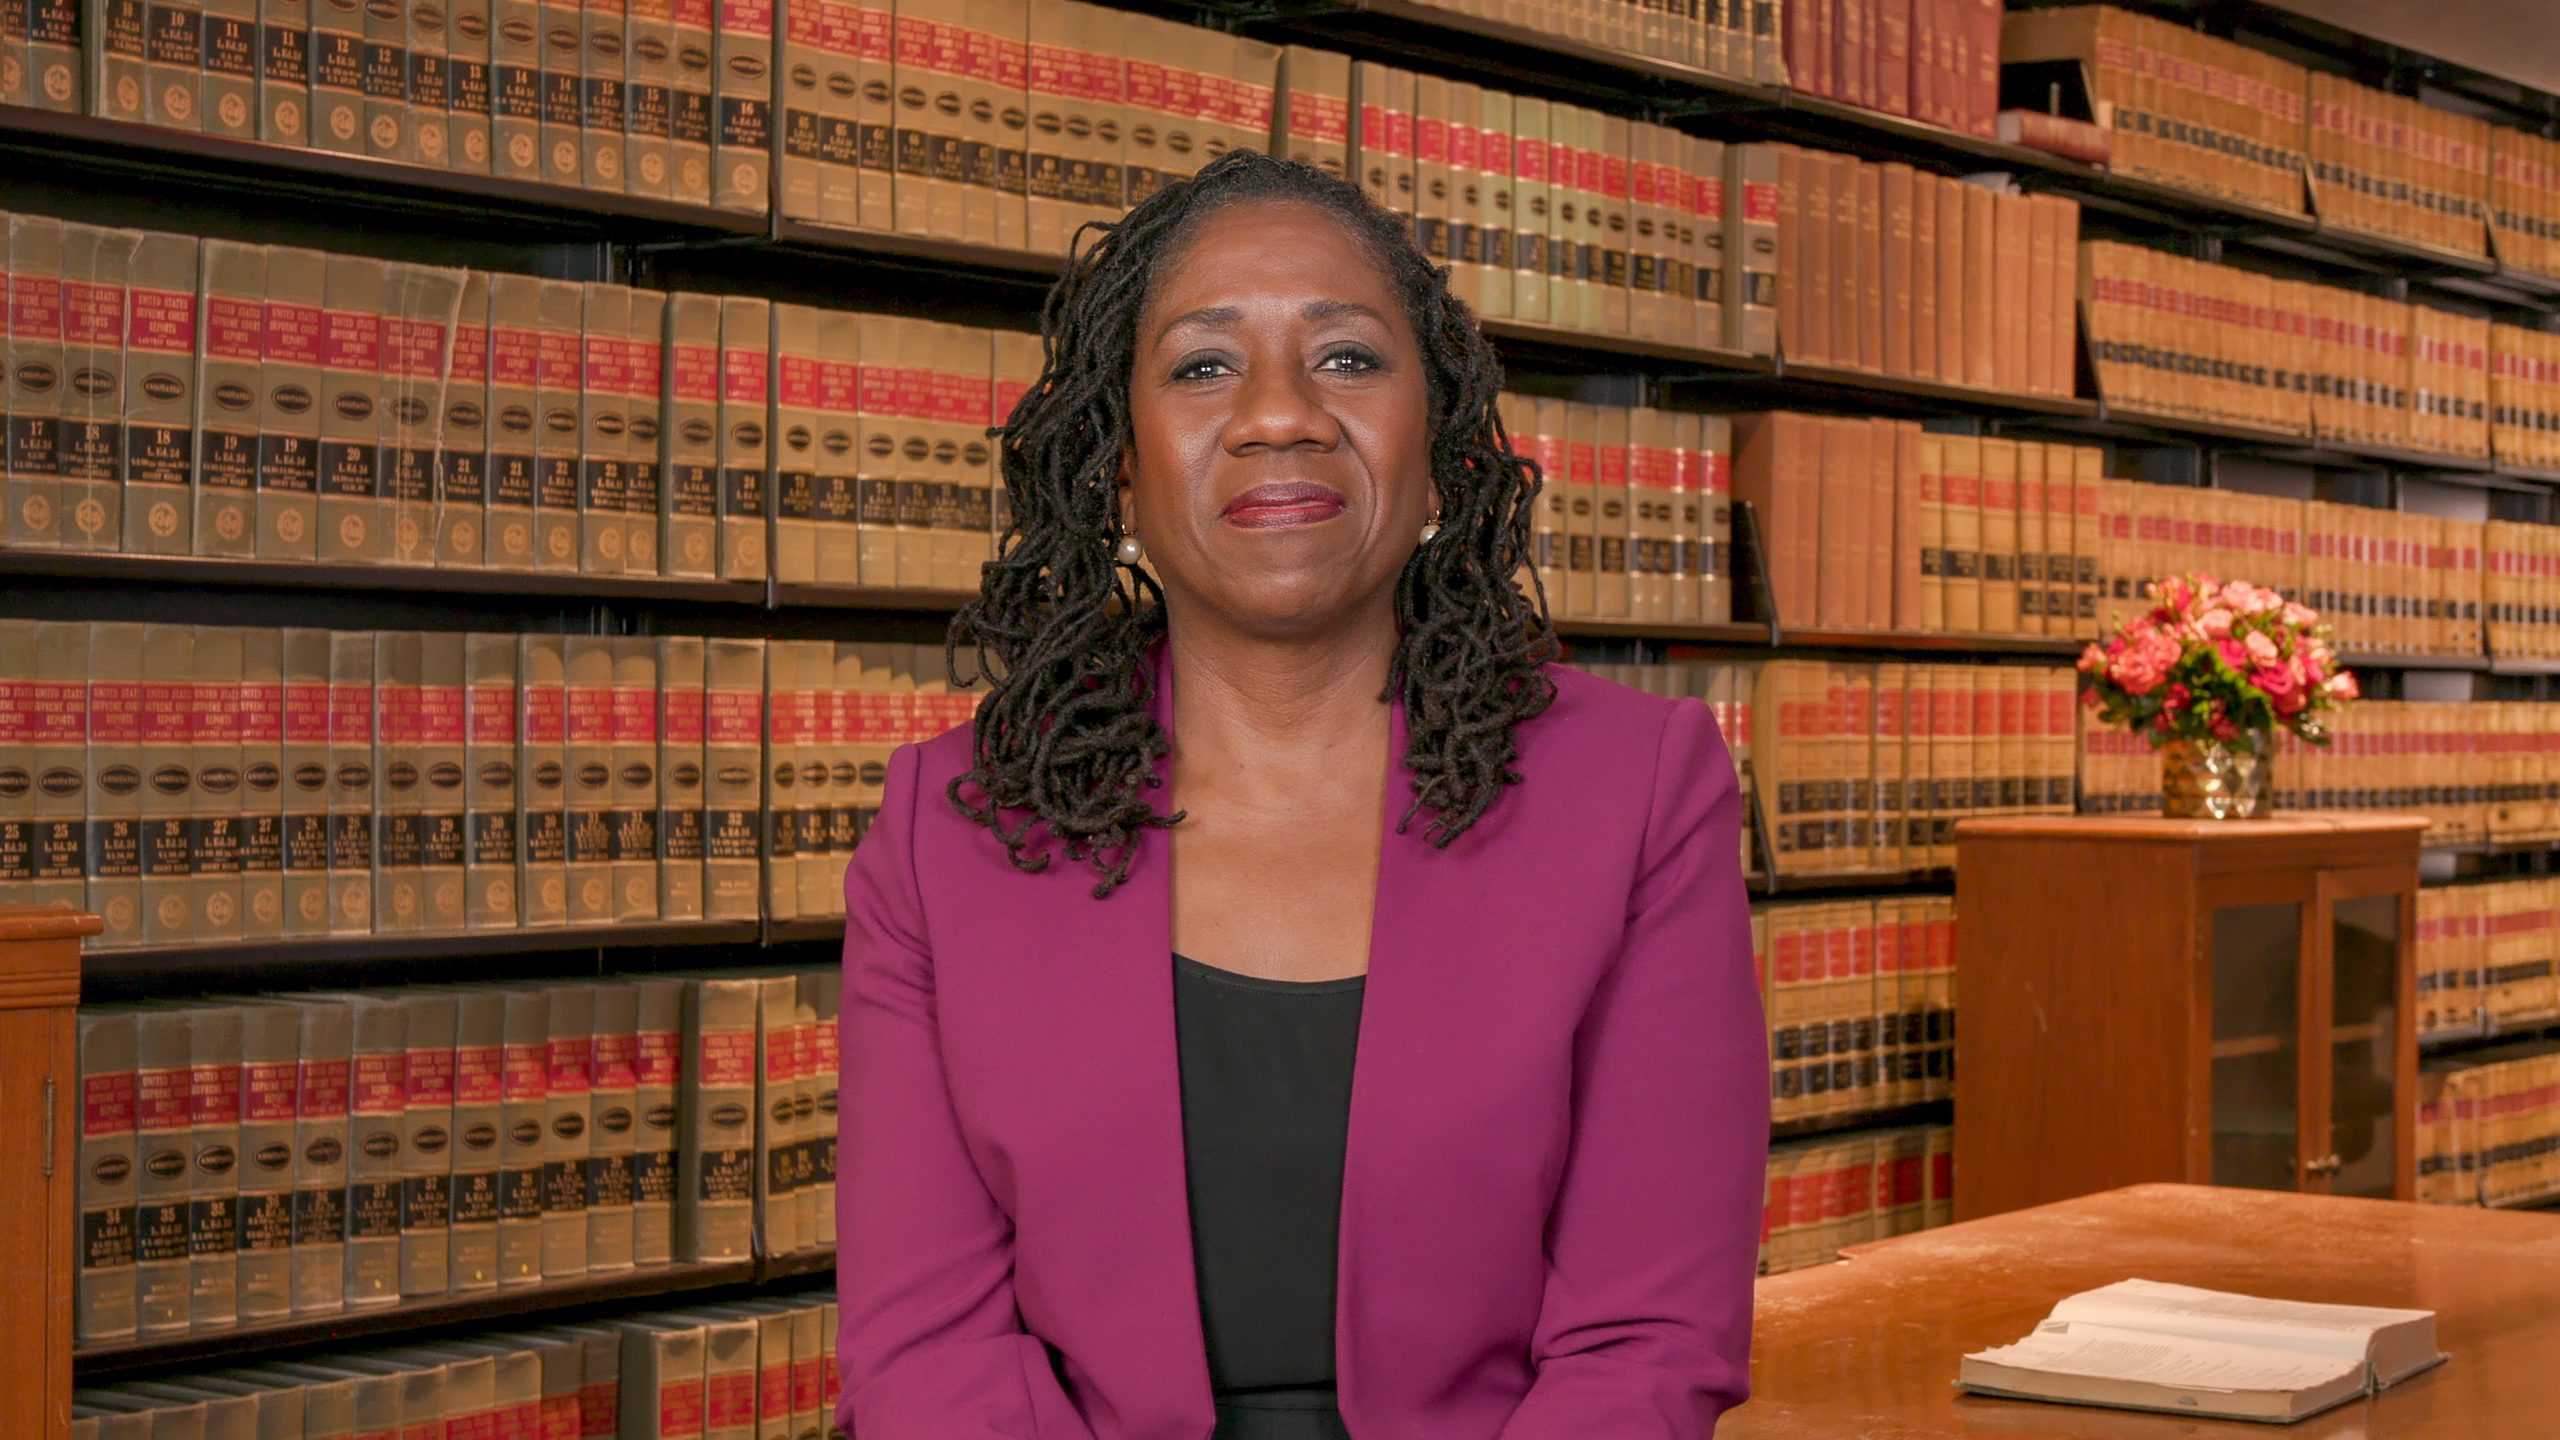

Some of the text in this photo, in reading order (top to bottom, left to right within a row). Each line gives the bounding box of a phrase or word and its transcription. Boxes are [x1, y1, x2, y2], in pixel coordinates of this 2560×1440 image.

[171, 11, 185, 26] 10
[226, 22, 240, 38] 11
[282, 31, 295, 46] 11
[337, 38, 349, 53] 12
[378, 48, 391, 63] 12
[515, 70, 528, 84] 14
[602, 81, 614, 95] 15
[647, 88, 659, 102] 15
[741, 102, 754, 115] 16
[138, 294, 188, 309] UNITED STATES
[136, 307, 188, 322] SUPREME COURT
[149, 321, 176, 334] REPORTS
[31, 421, 43, 437] 17
[156, 430, 171, 444] 18
[224, 435, 238, 450] 19
[284, 438, 298, 453] 19
[347, 448, 360, 462] 20
[458, 458, 470, 473] 21
[510, 461, 522, 476] 21
[556, 461, 569, 476] 22
[605, 463, 617, 478] 22
[63, 688, 85, 699] STATE
[121, 688, 139, 698] STAT
[67, 701, 85, 712] COUR
[5, 824, 20, 839] 25
[54, 824, 69, 839] 25
[114, 822, 128, 837] 26
[166, 821, 179, 836] 26
[214, 820, 228, 835] 27
[259, 818, 272, 833] 27
[440, 818, 453, 832] 29
[374, 1184, 387, 1198] 37
[107, 1209, 121, 1224] 34
[161, 1208, 175, 1222] 35
[211, 1202, 225, 1216] 35
